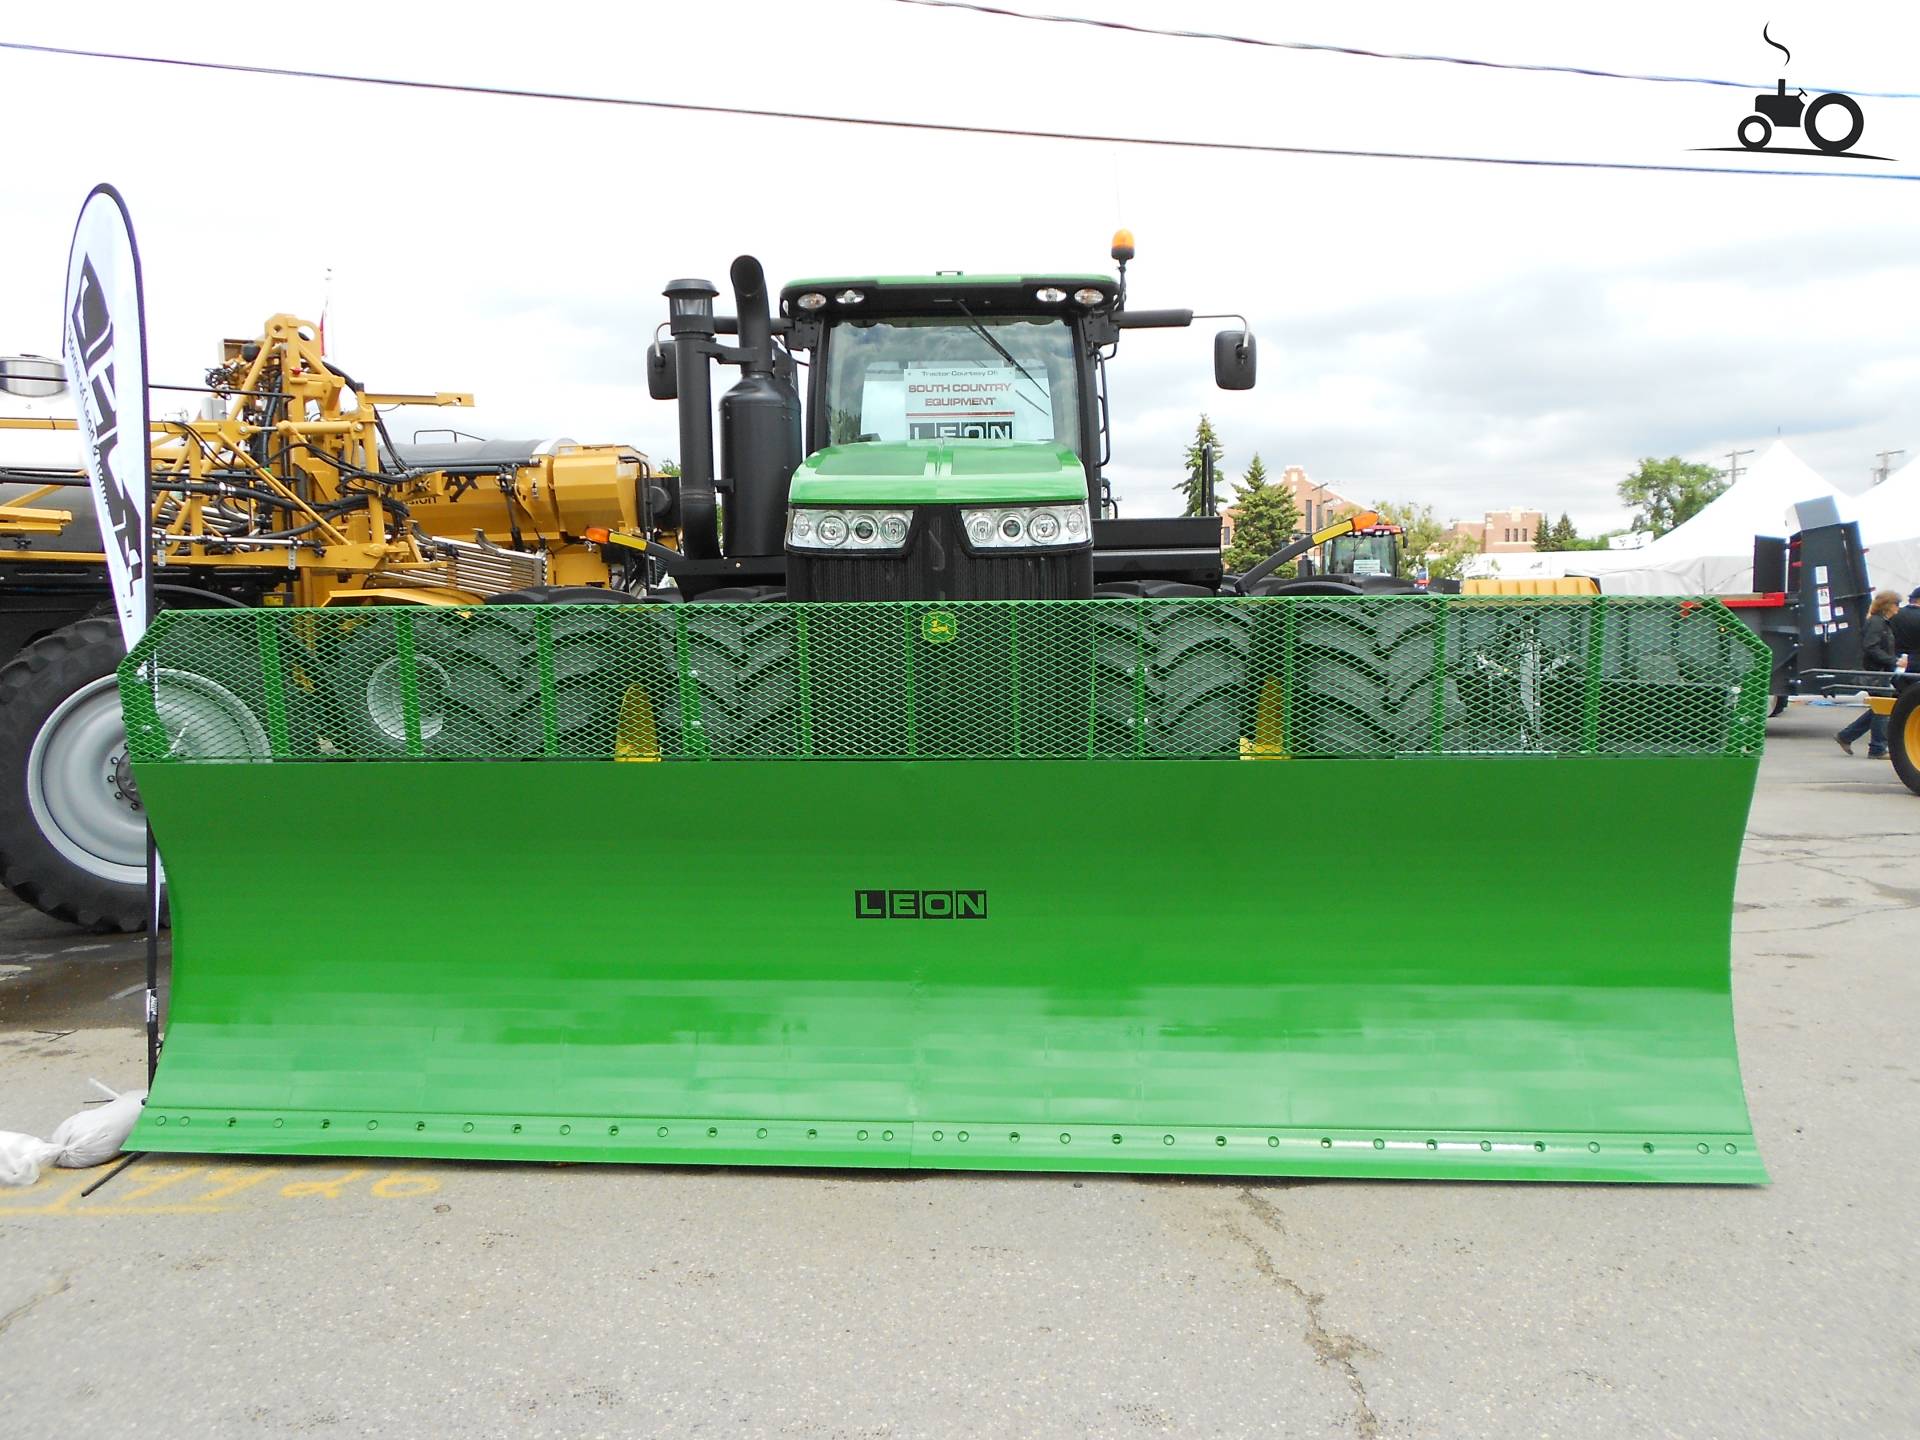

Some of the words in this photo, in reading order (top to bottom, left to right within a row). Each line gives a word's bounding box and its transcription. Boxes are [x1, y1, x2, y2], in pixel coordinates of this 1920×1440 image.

[908, 384, 951, 393] SOUTH
[952, 383, 1012, 393] COUNTRY
[925, 397, 997, 407] EQUIPMENT
[857, 891, 987, 918] LEON
